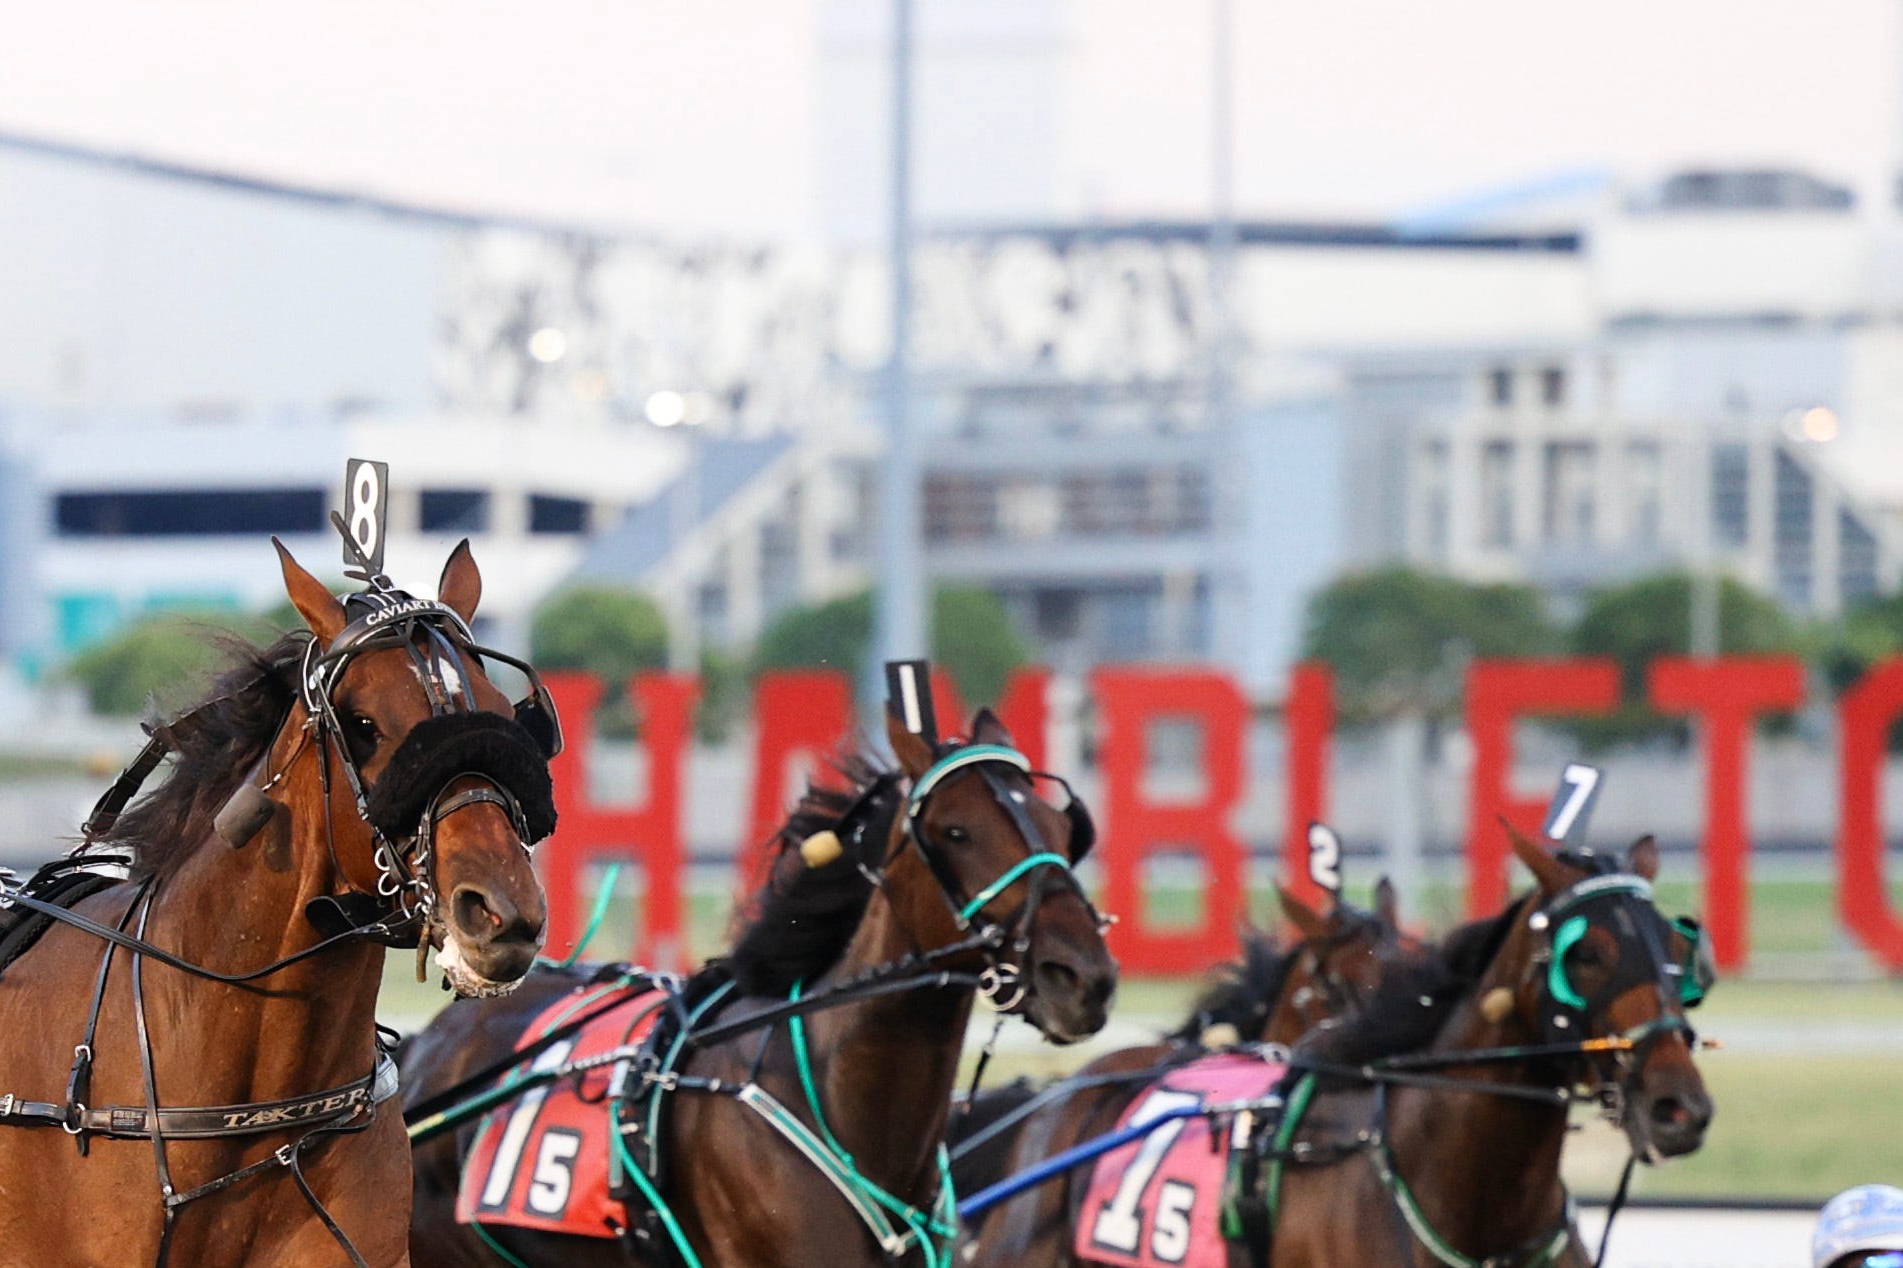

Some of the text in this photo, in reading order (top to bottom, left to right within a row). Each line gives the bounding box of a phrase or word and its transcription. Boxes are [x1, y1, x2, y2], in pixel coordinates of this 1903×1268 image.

[350, 462, 379, 561] 8
[365, 600, 431, 626] CAVIART
[899, 664, 922, 734] 1
[1548, 763, 1598, 840] 7
[1308, 823, 1339, 890] 2
[224, 1087, 369, 1129] TAKTER
[528, 1131, 580, 1214] 5
[1151, 1180, 1196, 1262] 5
